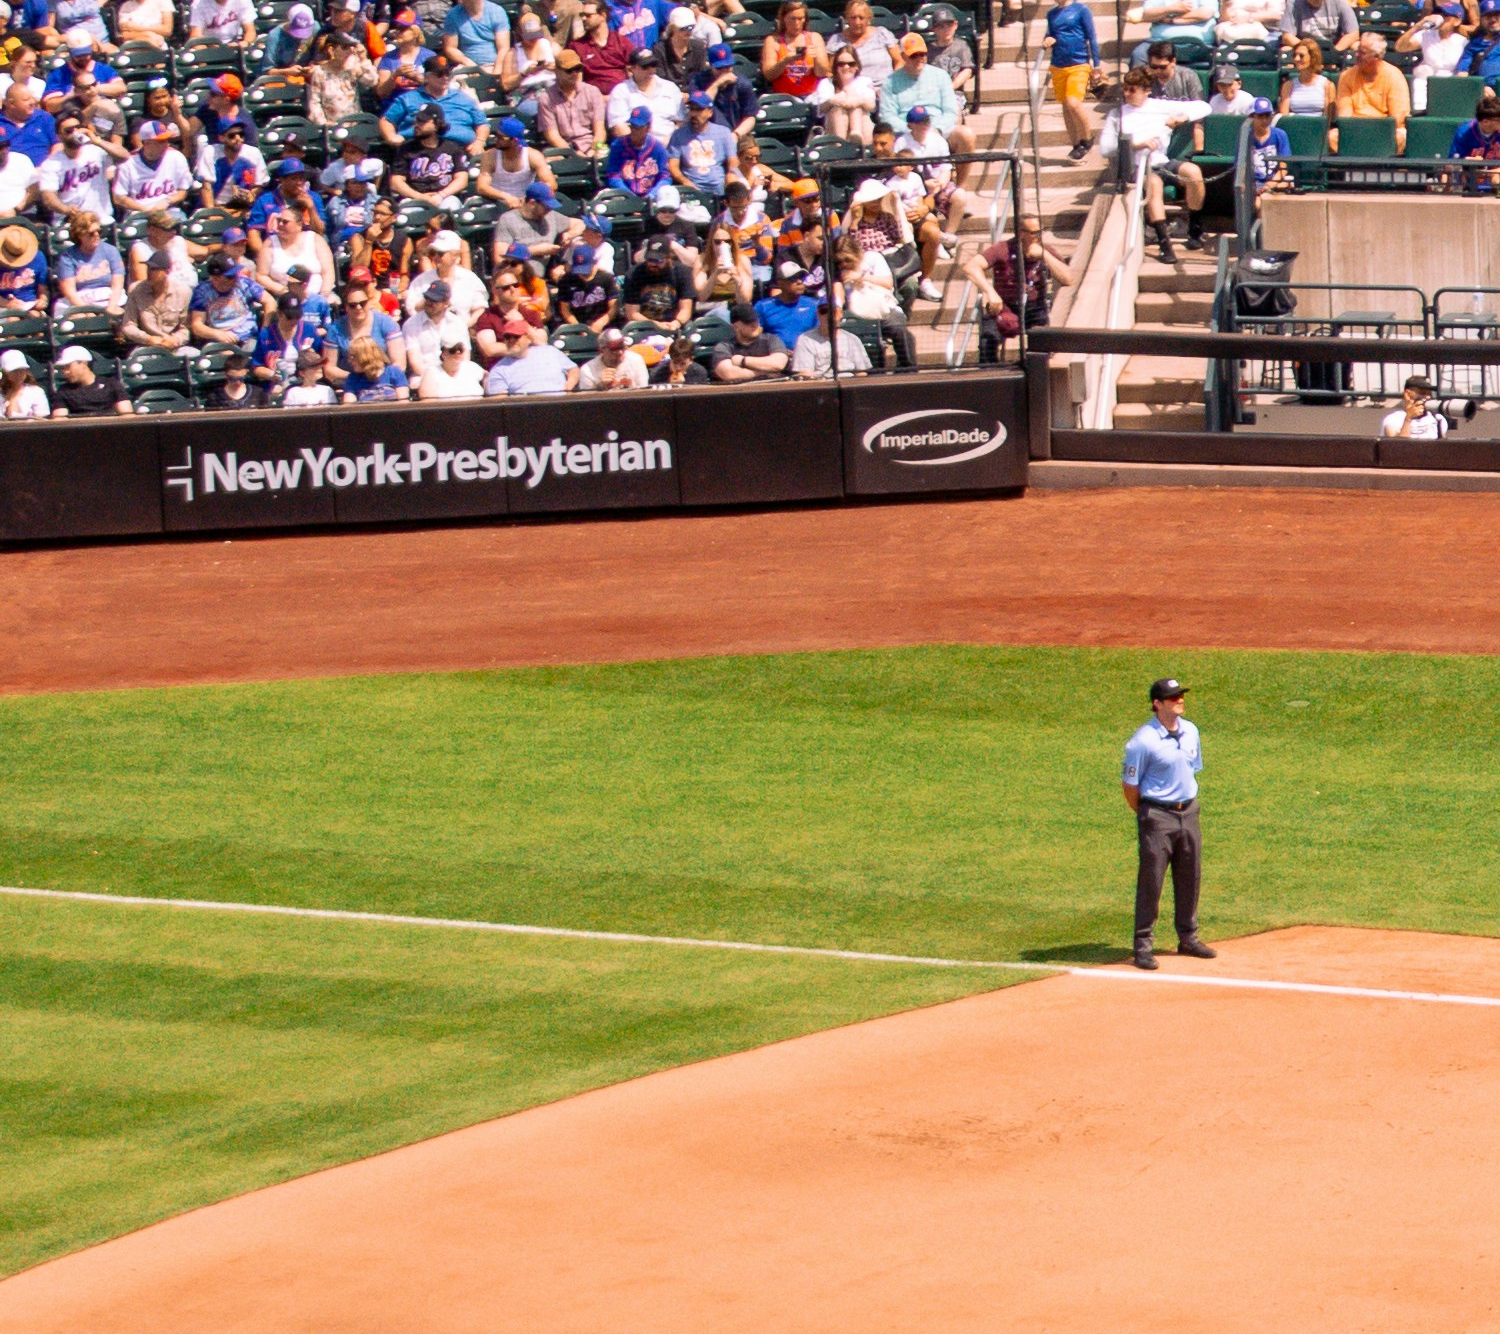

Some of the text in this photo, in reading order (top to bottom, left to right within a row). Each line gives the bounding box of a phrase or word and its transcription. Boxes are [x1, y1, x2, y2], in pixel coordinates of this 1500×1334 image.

[410, 153, 454, 176] Mets
[60, 166, 100, 191] Mets
[139, 179, 175, 200] Mets
[880, 428, 990, 450] ImperialDade
[203, 431, 672, 494] NewYork-Presbyterian
